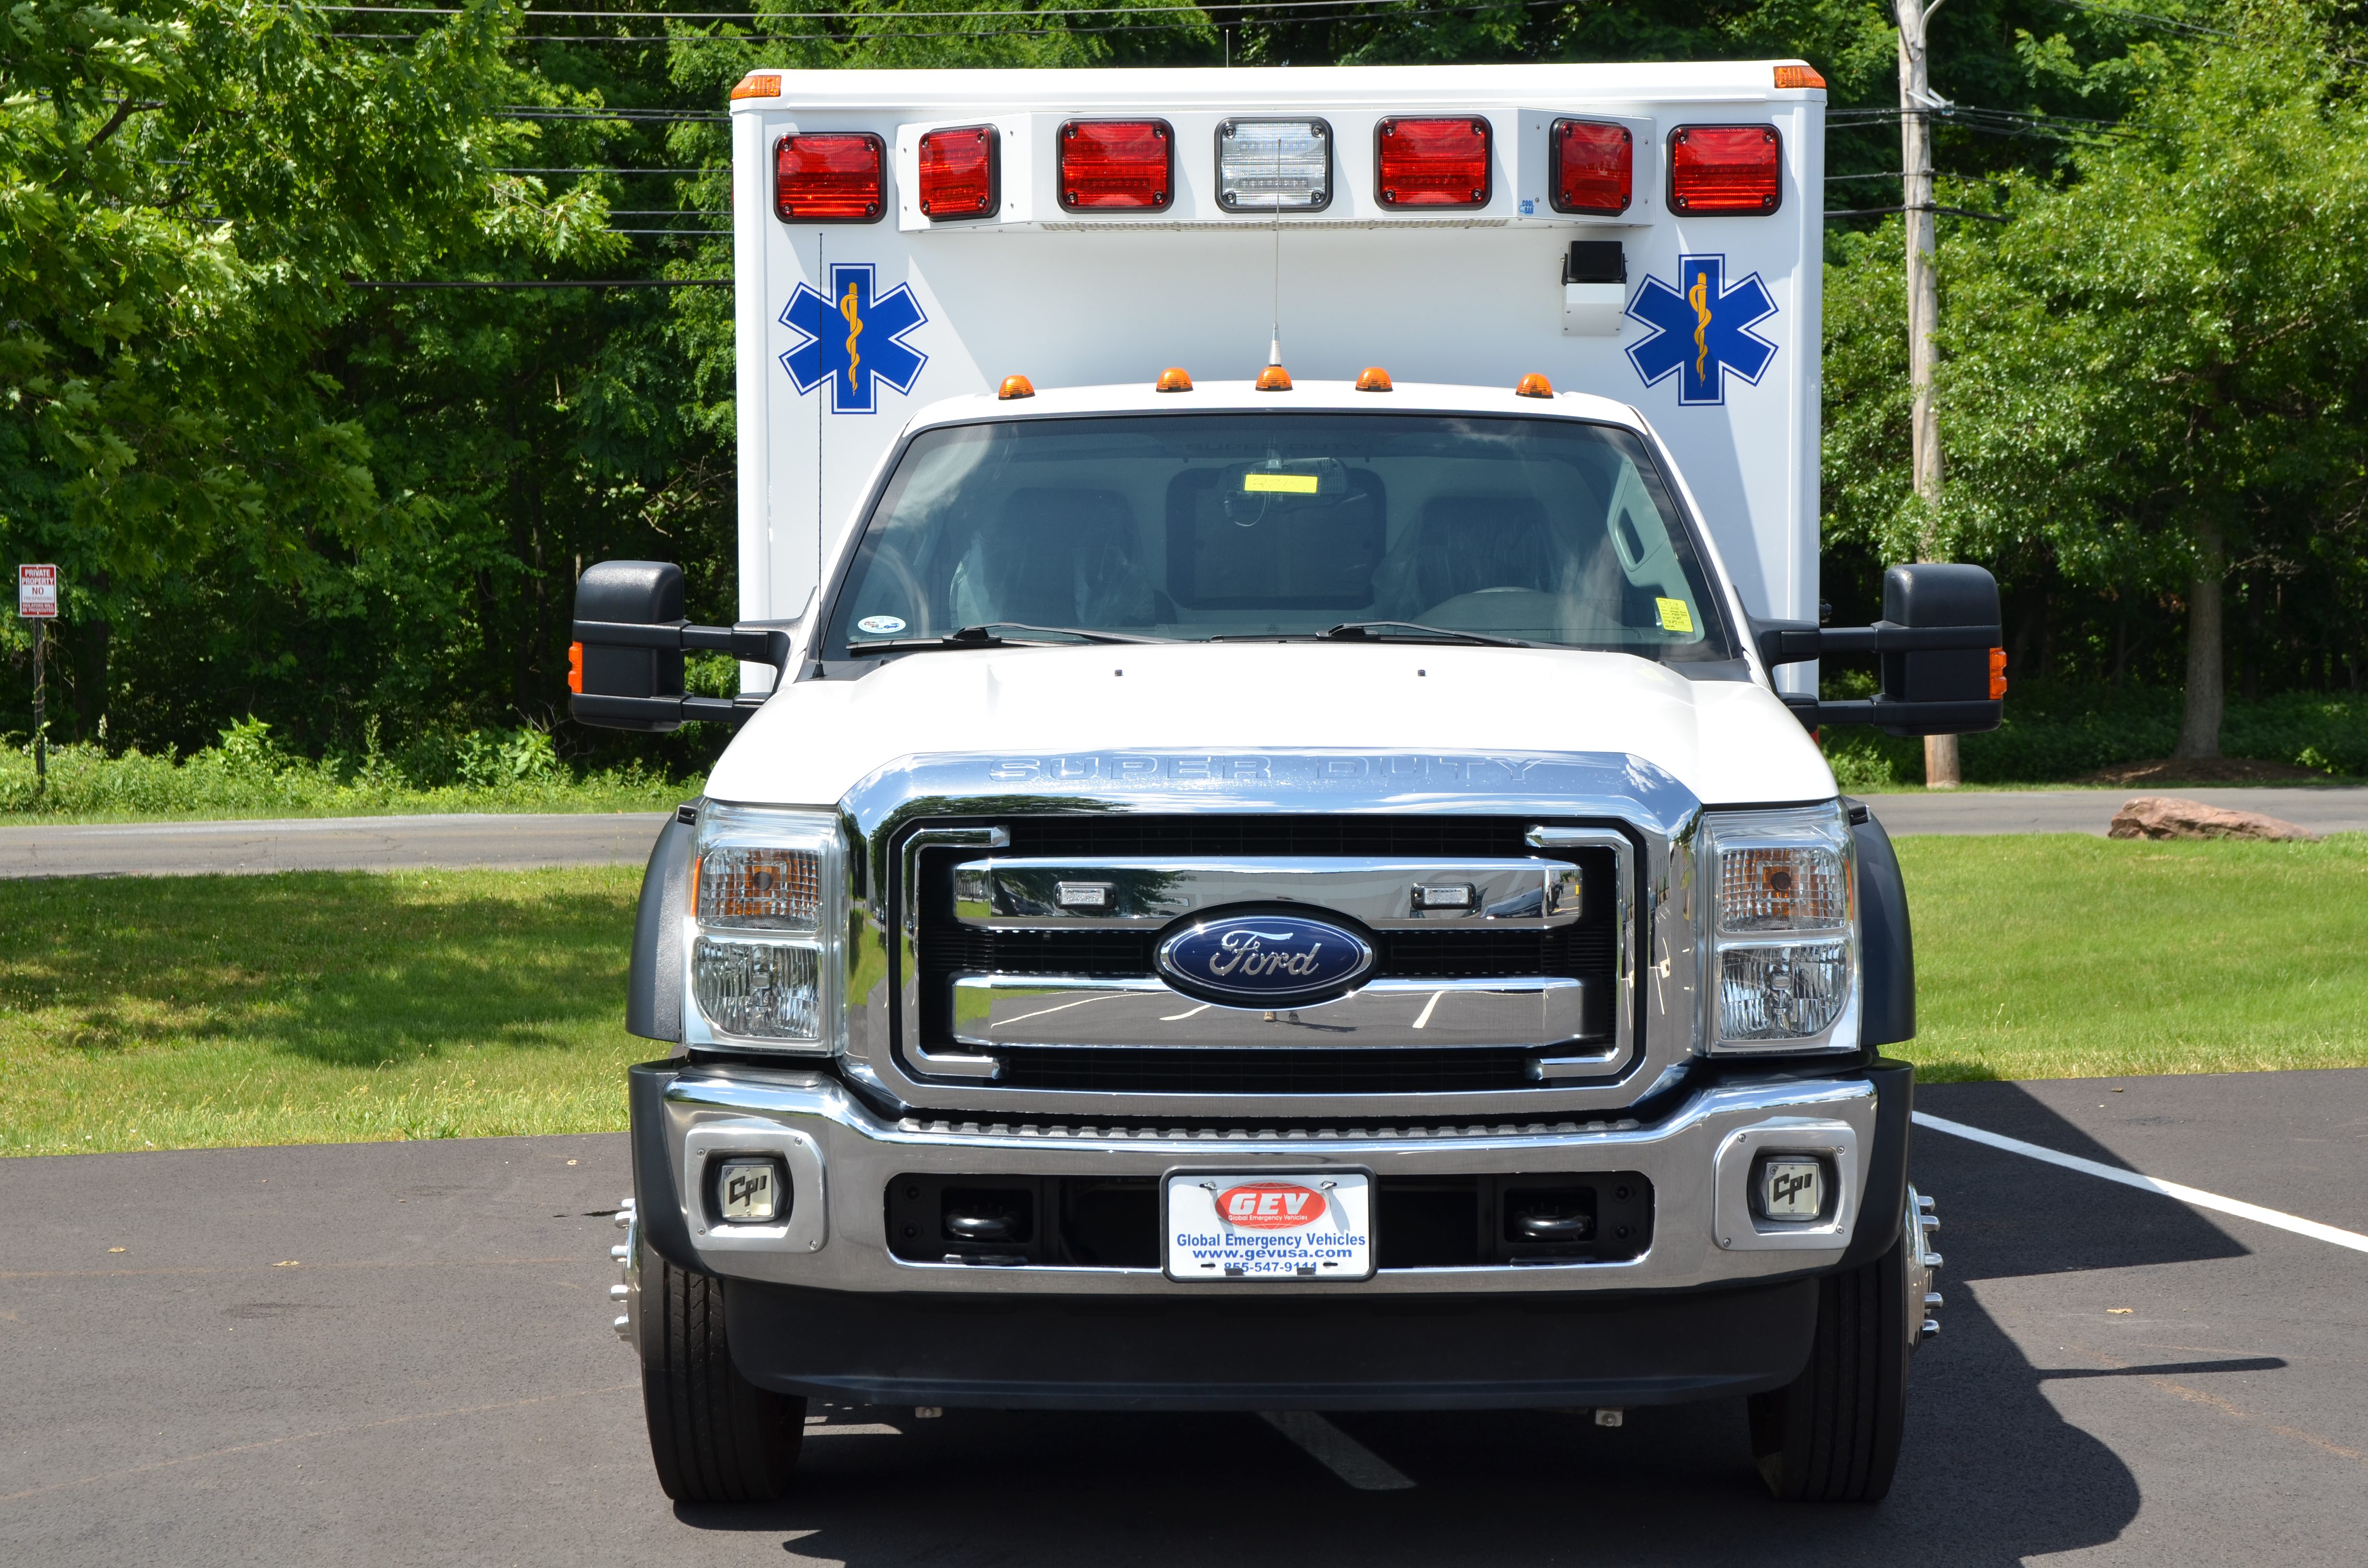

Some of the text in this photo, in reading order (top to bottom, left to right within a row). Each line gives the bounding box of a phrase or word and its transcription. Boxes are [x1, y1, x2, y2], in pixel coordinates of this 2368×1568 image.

[25, 569, 50, 577] PRIVATE
[32, 587, 44, 595] NO
[988, 756, 1544, 782] SUPER DUTY
[1209, 930, 1322, 976] Ford
[1229, 1193, 1310, 1215] GEV
[1177, 1233, 1366, 1249] Global Emergency Vehicles
[1192, 1249, 1352, 1261] www.gevusa.com
